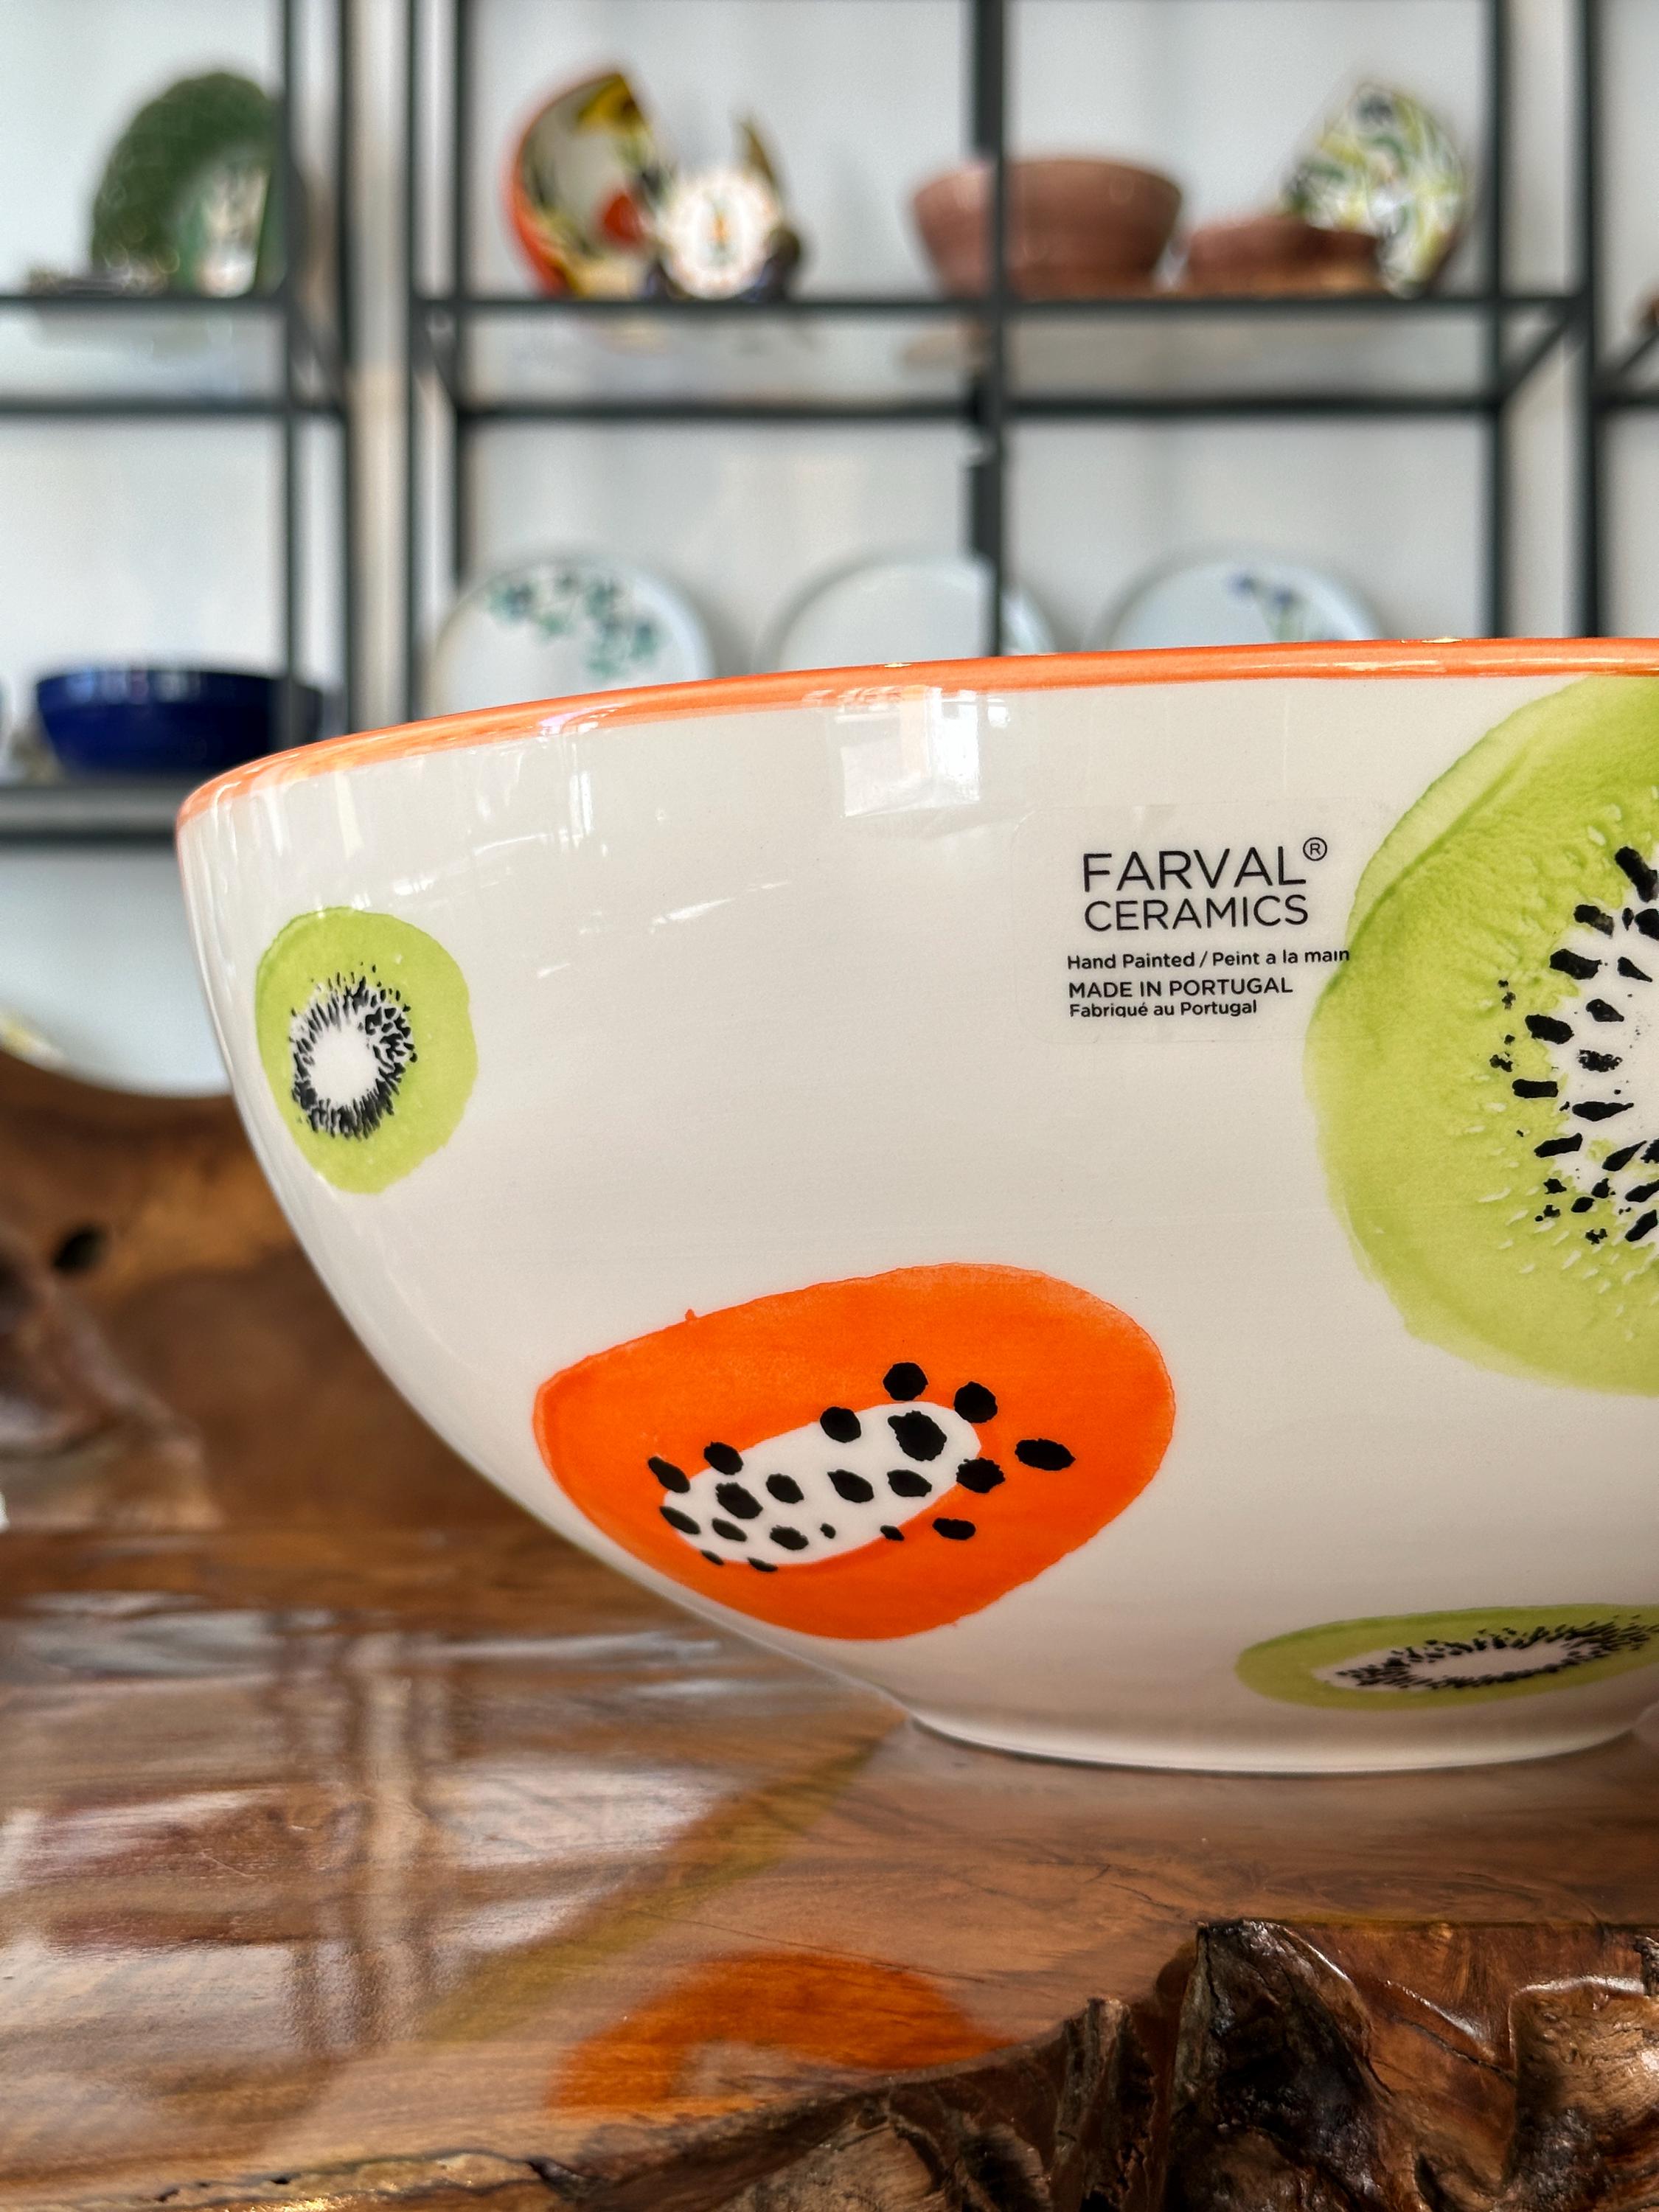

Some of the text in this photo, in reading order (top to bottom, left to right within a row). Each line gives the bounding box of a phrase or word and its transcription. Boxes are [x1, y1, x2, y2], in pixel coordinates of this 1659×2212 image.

[1084, 894, 1309, 932] CERAMICS
[1067, 953, 1116, 970] Hand
[1122, 952, 1195, 969] Painted
[1199, 950, 1208, 967] /
[1212, 952, 1260, 967] Peint
[1282, 949, 1298, 964] la
[1304, 950, 1351, 963] main
[1068, 977, 1293, 998] MADE IN PORTUGAL
[1069, 999, 1257, 1018] Fabriqué au Portugal
